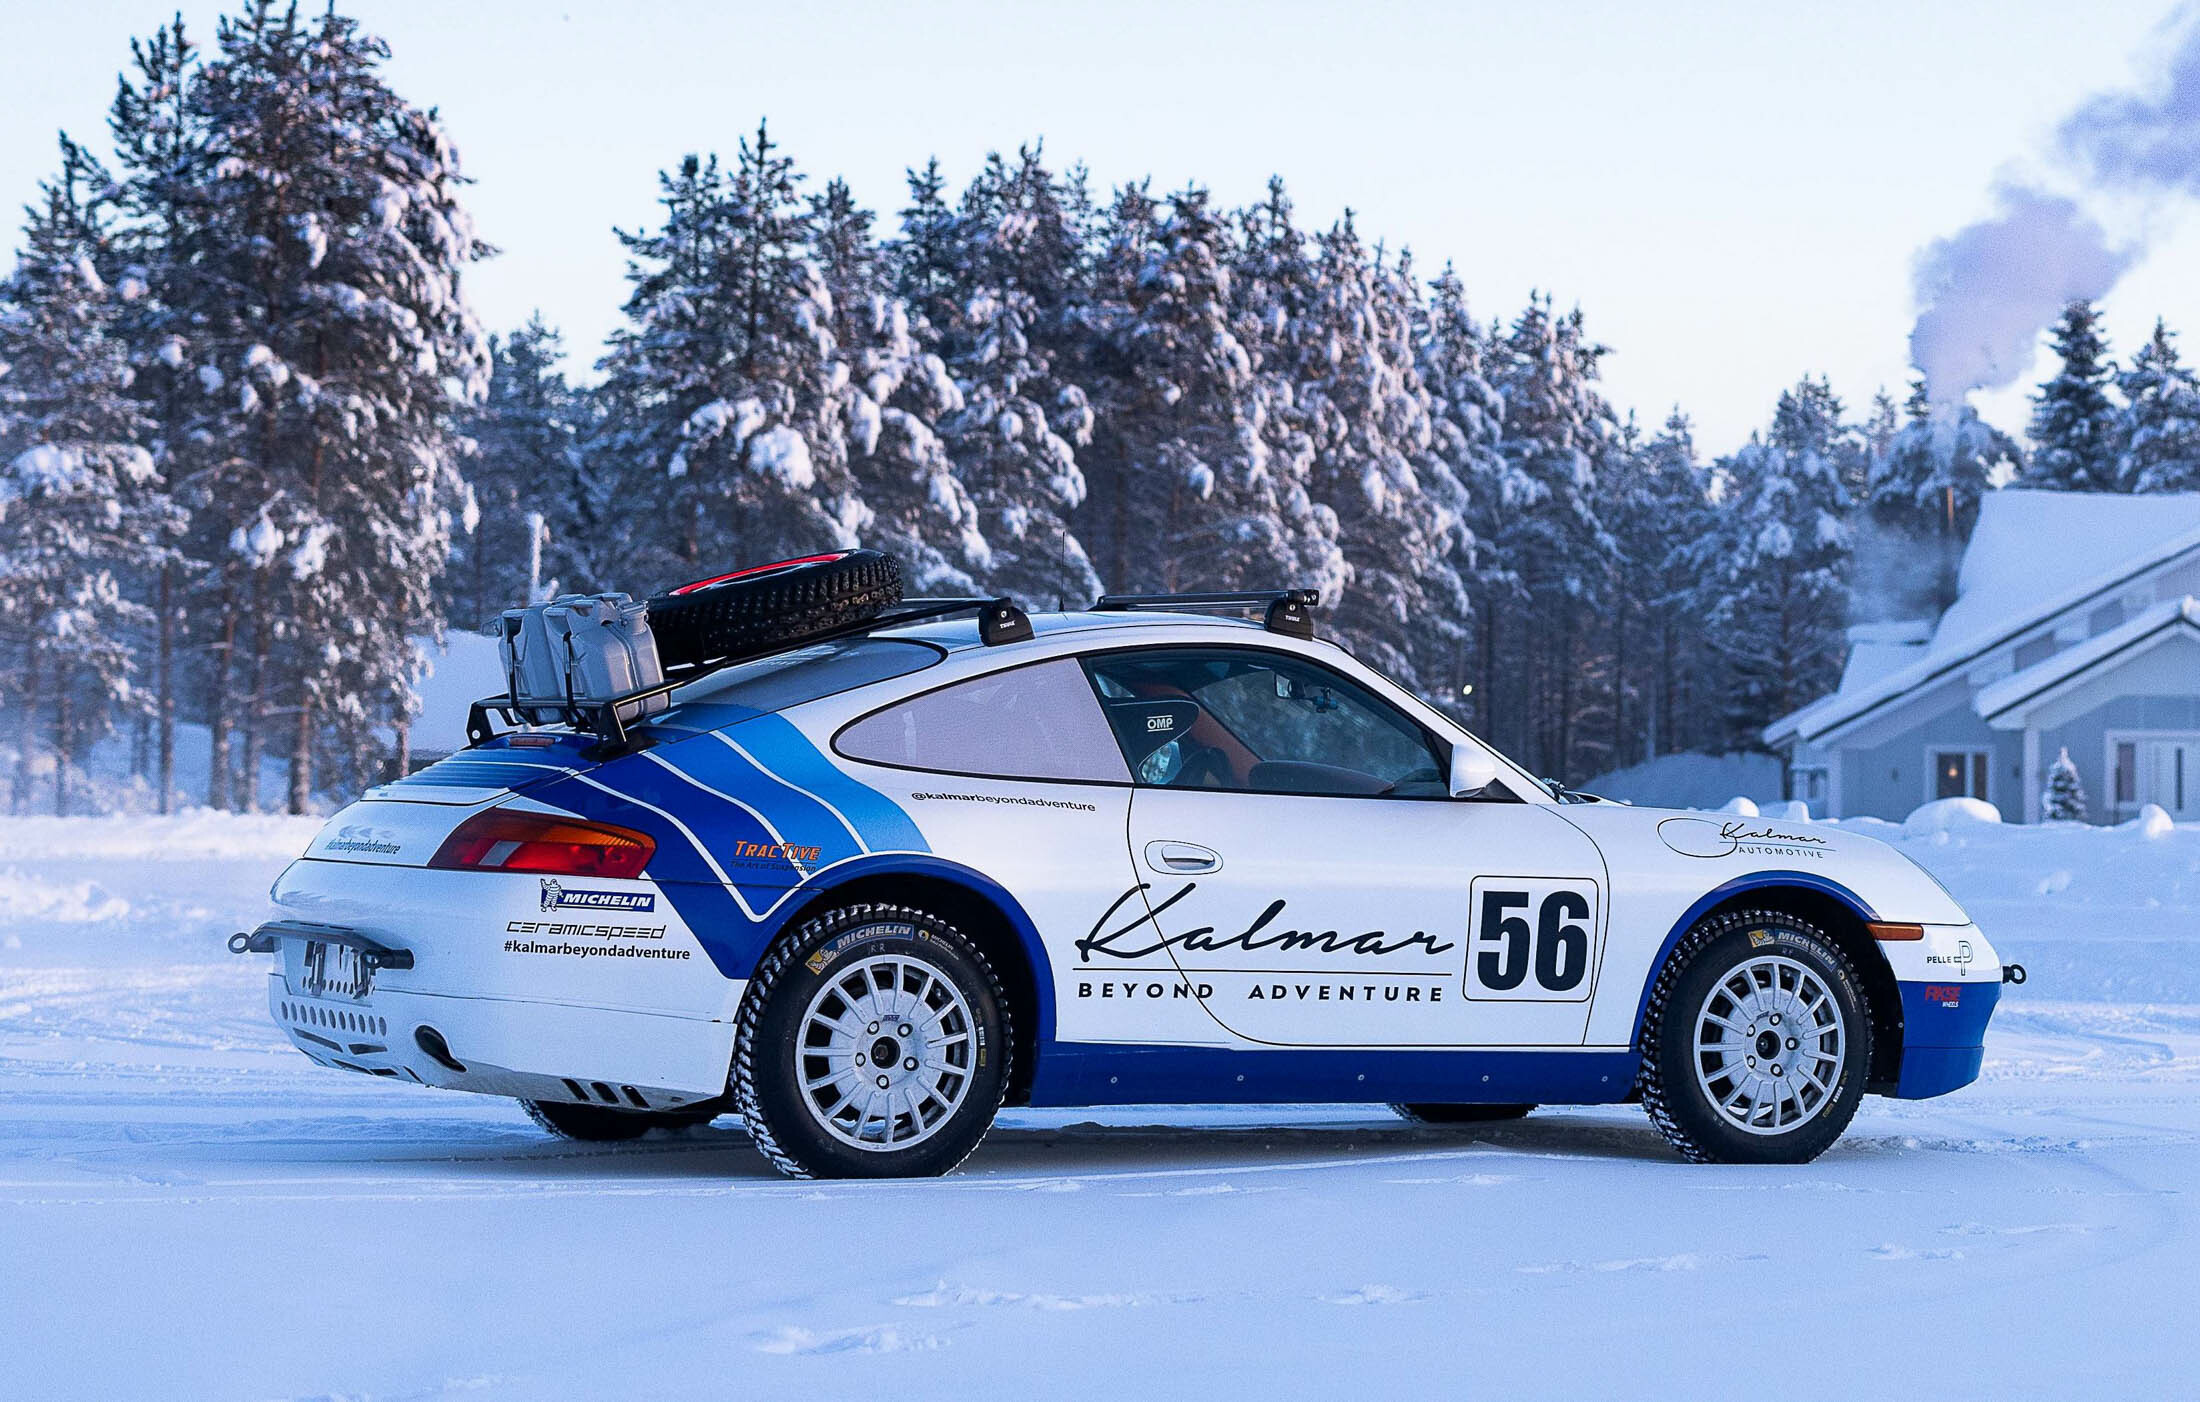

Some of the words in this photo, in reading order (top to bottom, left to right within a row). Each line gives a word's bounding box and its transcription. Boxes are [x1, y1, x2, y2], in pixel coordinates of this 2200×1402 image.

[1147, 717, 1173, 730] OMP
[911, 792, 1096, 812] @kalmarbeyondadventure
[1720, 822, 1827, 844] Kalmar
[1738, 846, 1824, 859] AUTOMOTIVE
[563, 893, 652, 908] MICHELIN
[1075, 882, 1454, 963] Kalmar
[836, 925, 911, 949] MICHELIN
[1477, 890, 1591, 992] 56
[504, 940, 691, 960] #kalmarbeyondadventure
[1778, 931, 1836, 965] MICHELIN
[1926, 956, 1952, 964] PELLE
[1079, 982, 1214, 999] BEYOND
[1248, 984, 1442, 1002] ADVENTURE
